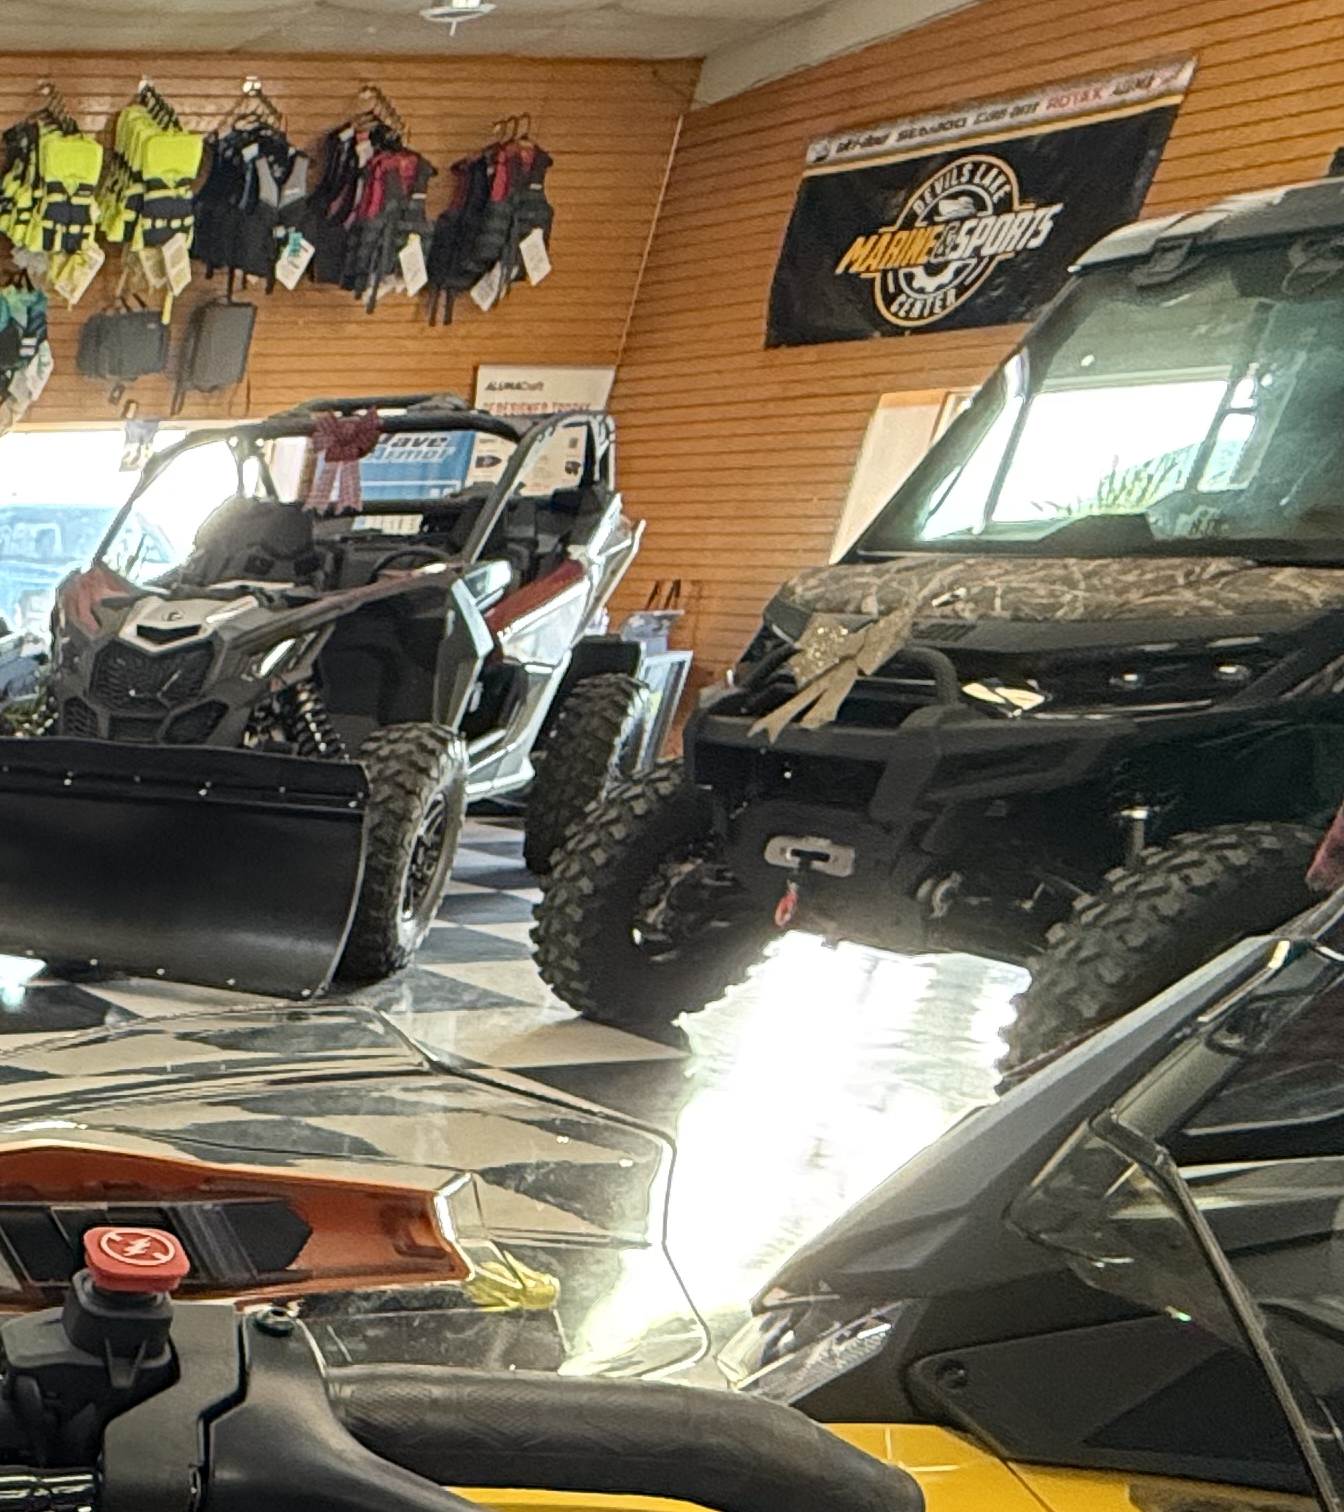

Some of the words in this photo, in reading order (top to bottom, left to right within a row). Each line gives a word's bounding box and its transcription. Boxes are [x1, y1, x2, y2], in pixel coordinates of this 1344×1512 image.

[913, 162, 971, 215] DEVILS
[973, 164, 1014, 204] LAKE
[835, 225, 946, 275] MARINE
[951, 203, 1065, 258] SPORTS
[889, 290, 958, 320] CENTER
